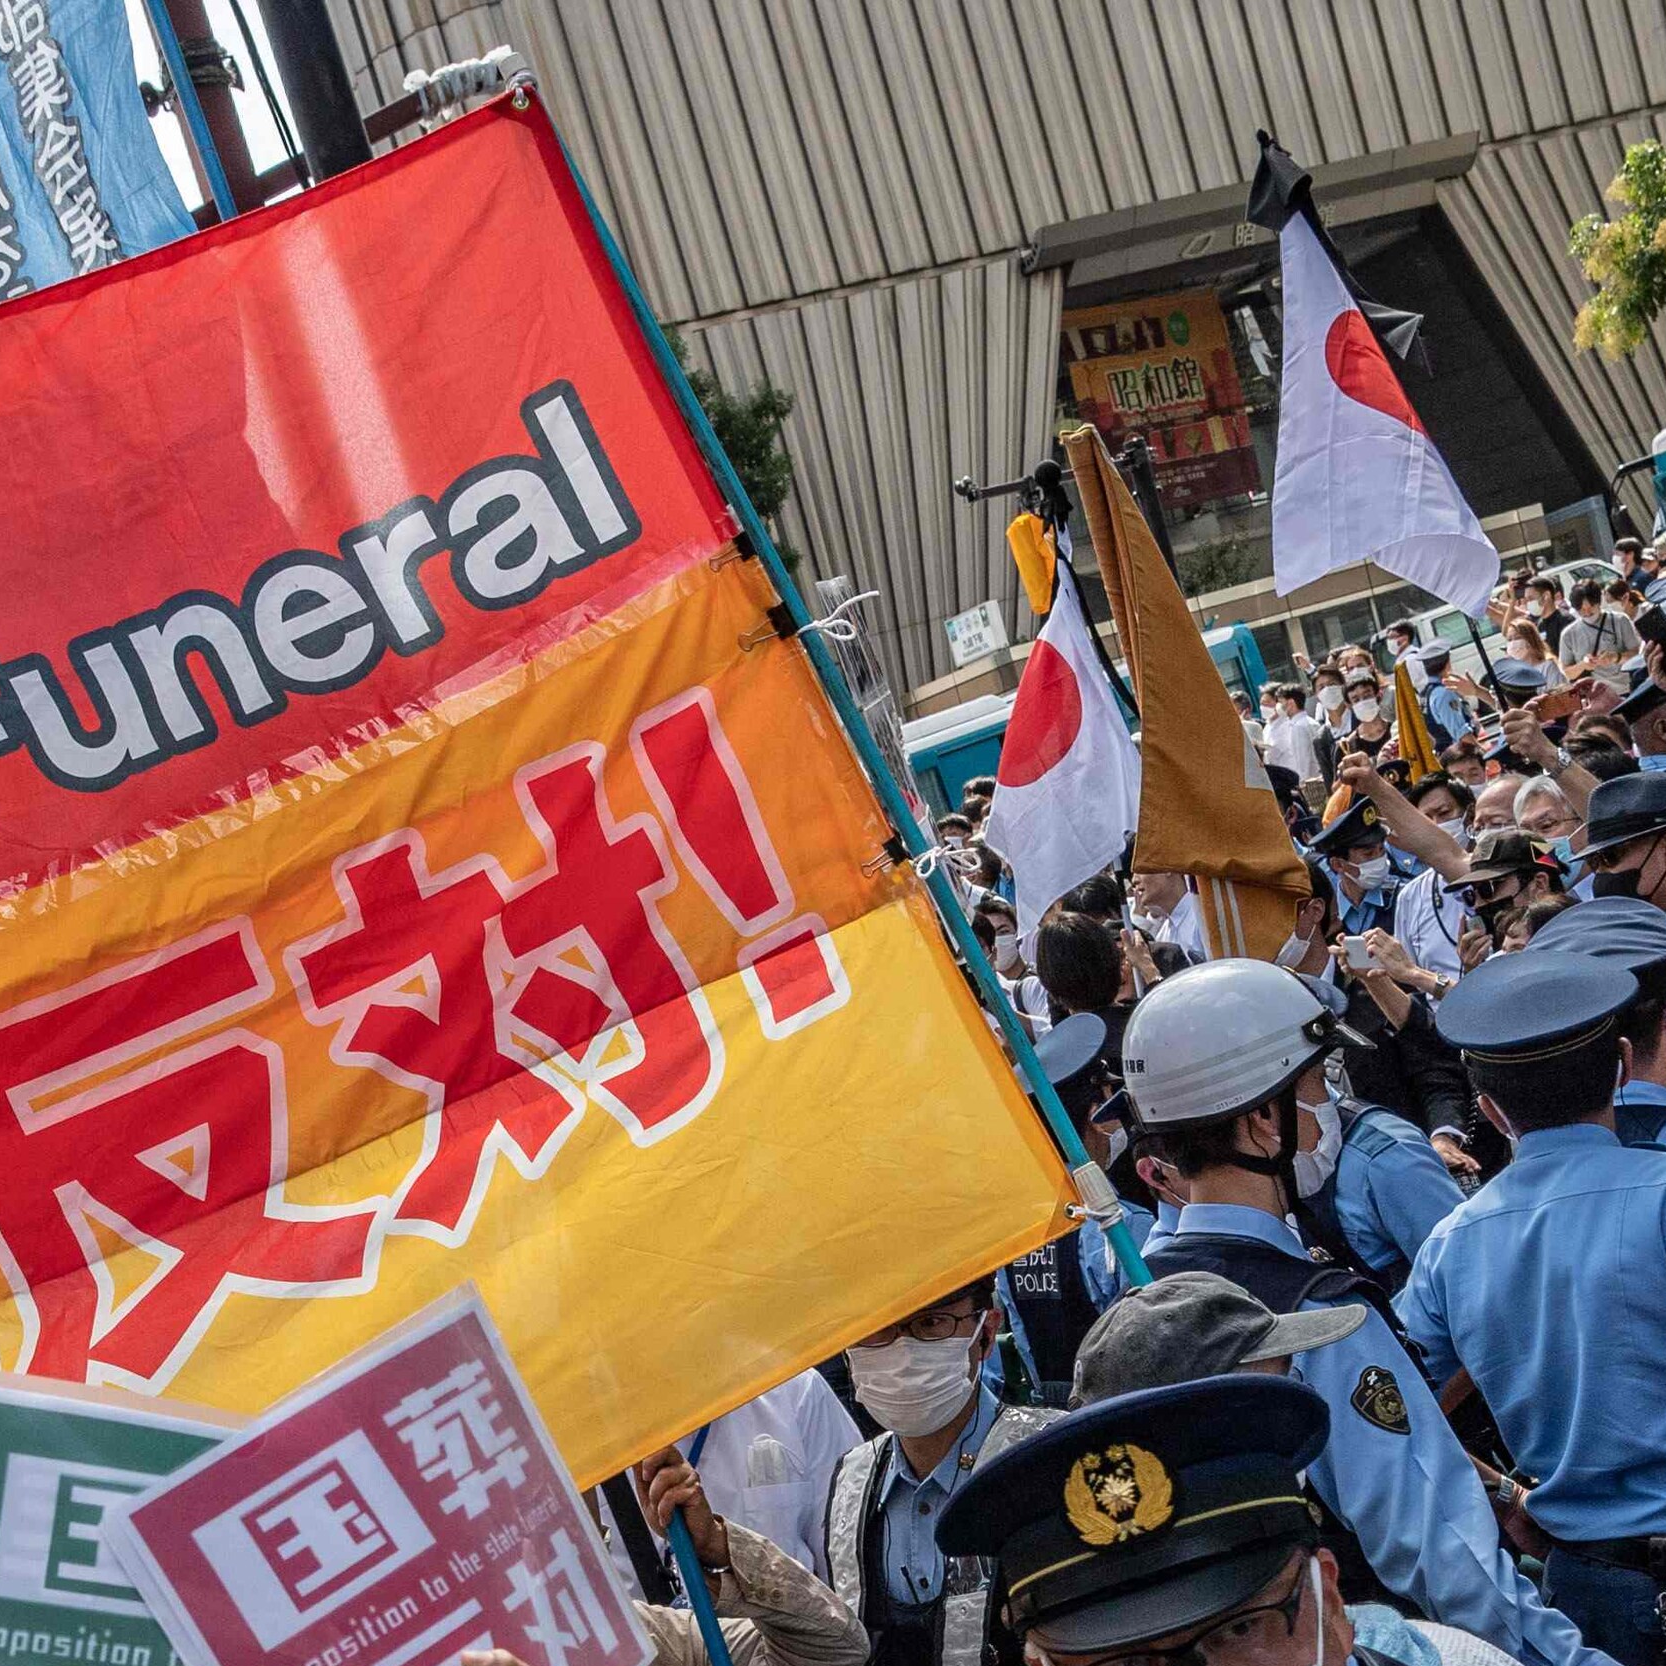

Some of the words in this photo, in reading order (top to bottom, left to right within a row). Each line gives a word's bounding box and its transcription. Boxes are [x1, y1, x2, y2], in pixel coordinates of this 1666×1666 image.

[1107, 355, 1205, 411] 昭和館
[192, 1360, 529, 1652] 国葬
[420, 1569, 449, 1602] to
[449, 1550, 483, 1584] the
[488, 1524, 521, 1561] state
